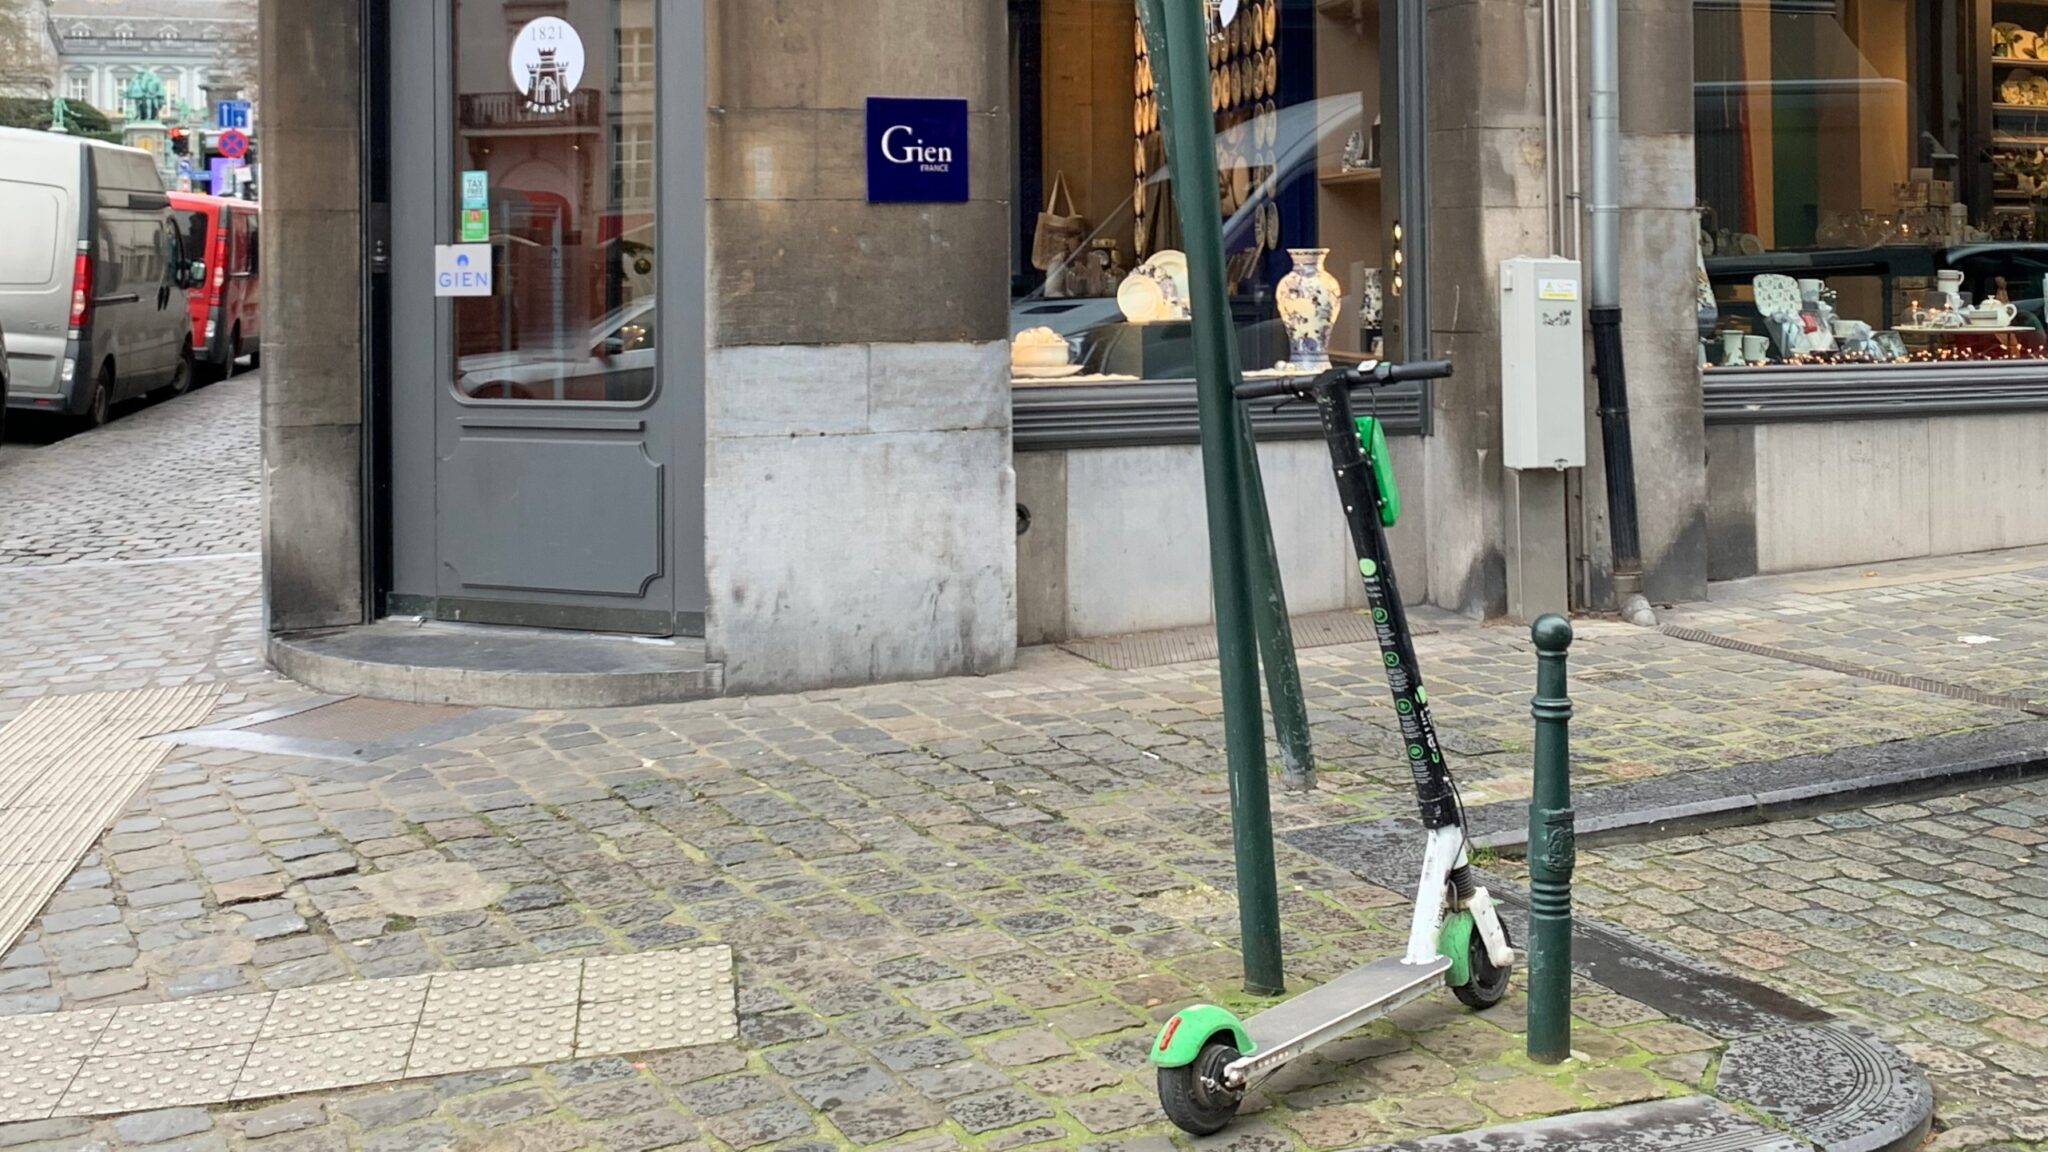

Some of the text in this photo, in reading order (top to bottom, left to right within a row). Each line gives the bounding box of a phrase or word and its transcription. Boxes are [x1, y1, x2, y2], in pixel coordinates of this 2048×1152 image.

[531, 25, 563, 40] 1821
[526, 99, 570, 113] FRANCE
[881, 125, 952, 163] Gien
[920, 164, 949, 172] FRANCE
[467, 179, 483, 187] TAX
[439, 272, 488, 287] GIEN
